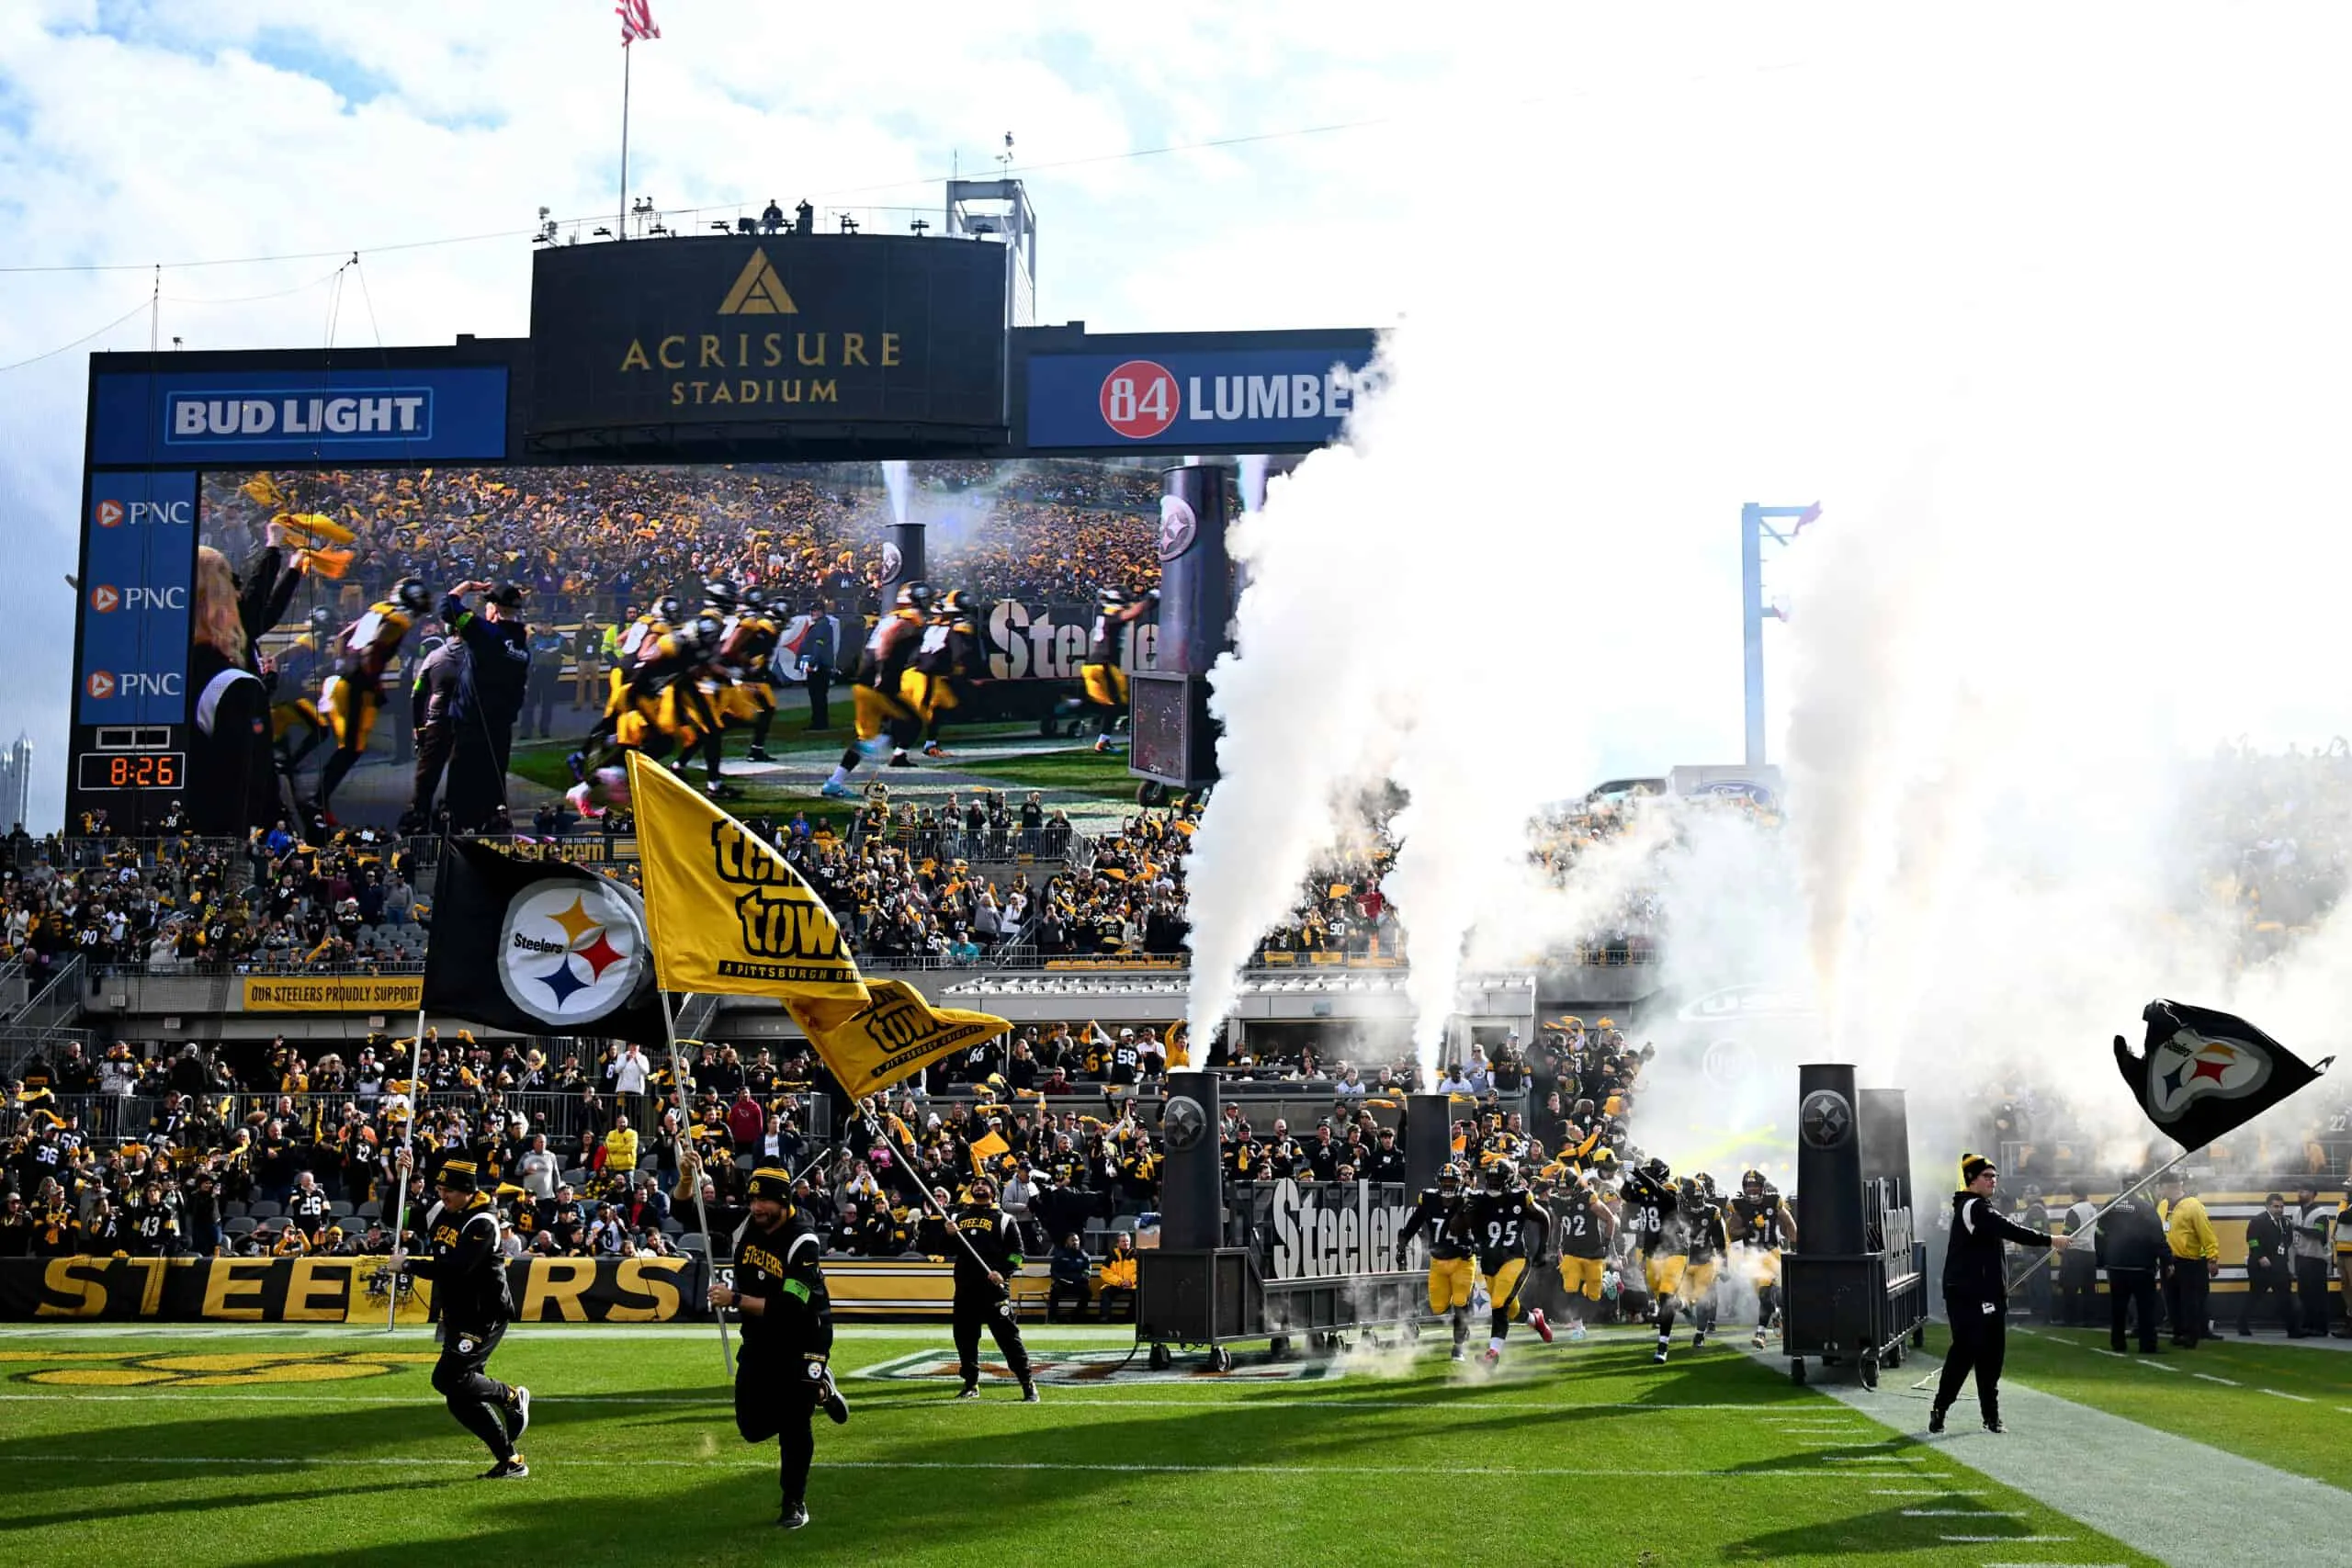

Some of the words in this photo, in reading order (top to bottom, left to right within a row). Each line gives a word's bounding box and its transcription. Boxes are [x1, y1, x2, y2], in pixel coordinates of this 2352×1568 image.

[620, 332, 901, 371] ACRISURE
[672, 379, 838, 405] STADIUM
[1110, 377, 1170, 422] 84
[175, 400, 276, 434] BUD
[283, 397, 423, 433] LIGHT
[129, 502, 190, 525] PNC
[125, 586, 186, 611] PNC
[120, 672, 182, 696] PNC
[111, 758, 173, 784] 8:26
[81, 930, 97, 944] 90
[1329, 922, 1345, 935] 90
[514, 932, 563, 953] Steelers
[927, 935, 941, 950] 90
[725, 964, 731, 973] A
[737, 965, 827, 980] PITTSBURGH
[251, 986, 271, 1001] OUR
[275, 986, 322, 1001] STEELERS
[326, 986, 370, 1001] PROUDLY
[374, 985, 419, 1001] SUPPORT
[969, 1046, 986, 1063] 66
[1117, 1048, 1136, 1066] 58
[166, 1116, 176, 1133] 7
[2329, 1115, 2346, 1132] 22
[37, 1145, 59, 1164] 36
[300, 1197, 322, 1215] 26
[140, 1216, 161, 1237] 43
[1487, 1221, 1517, 1248] 95
[1562, 1215, 1586, 1236] 92
[34, 1256, 689, 1322] STEERS
